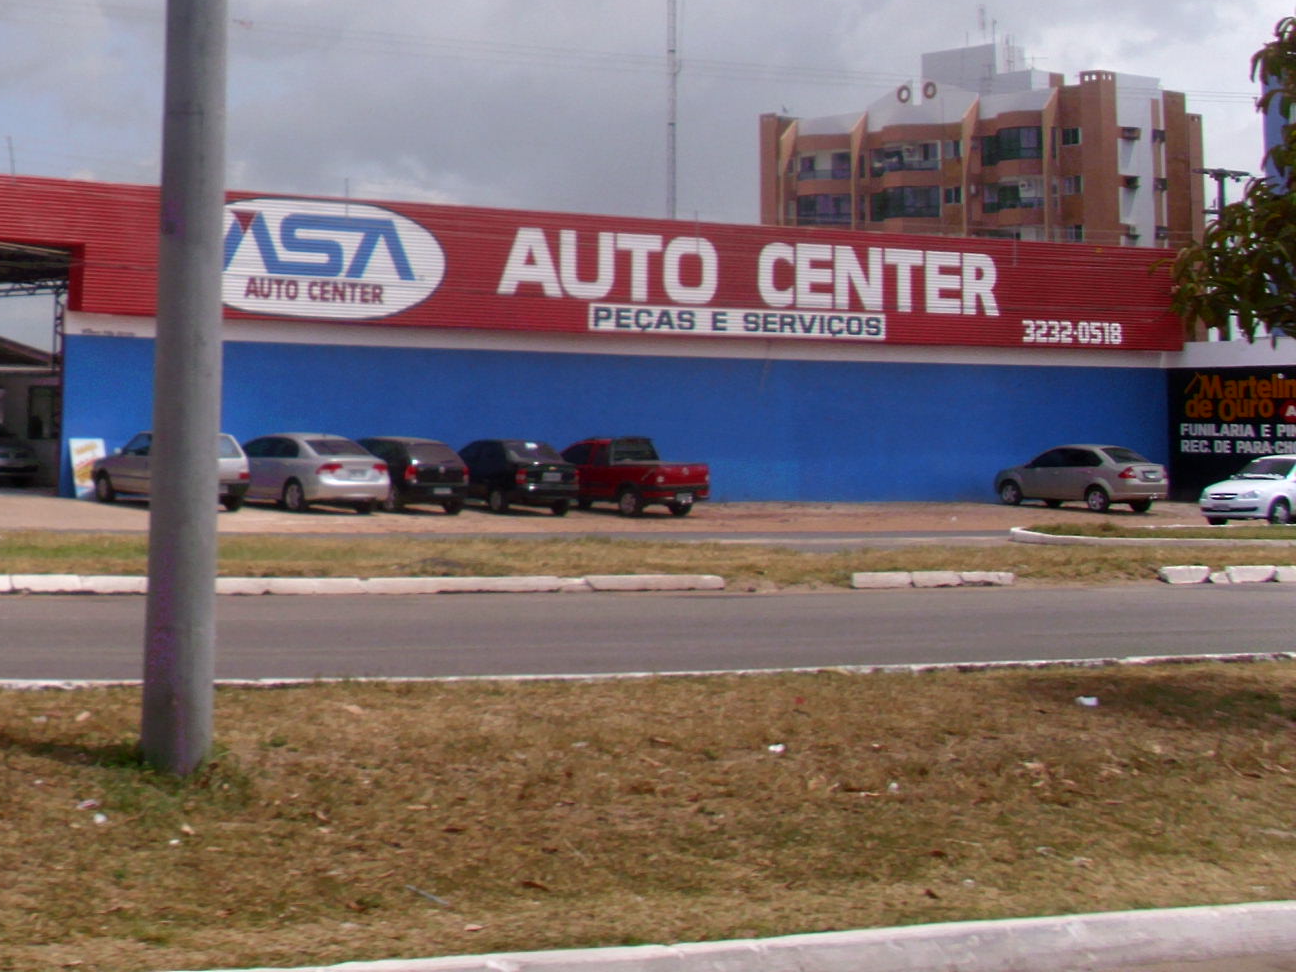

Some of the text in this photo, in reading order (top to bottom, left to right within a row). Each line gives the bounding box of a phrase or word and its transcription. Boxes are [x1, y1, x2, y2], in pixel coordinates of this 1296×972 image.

[223, 208, 416, 281] ASA
[497, 227, 1000, 317] AUTO CENTER
[244, 276, 385, 305] AUTO CENTER
[593, 306, 882, 337] PEÇAS E SERVIÇOS
[1185, 394, 1275, 422] de Ouro
[1180, 423, 1255, 437] FUNILARIA
[1260, 424, 1271, 437] E
[1213, 440, 1232, 453] DE
